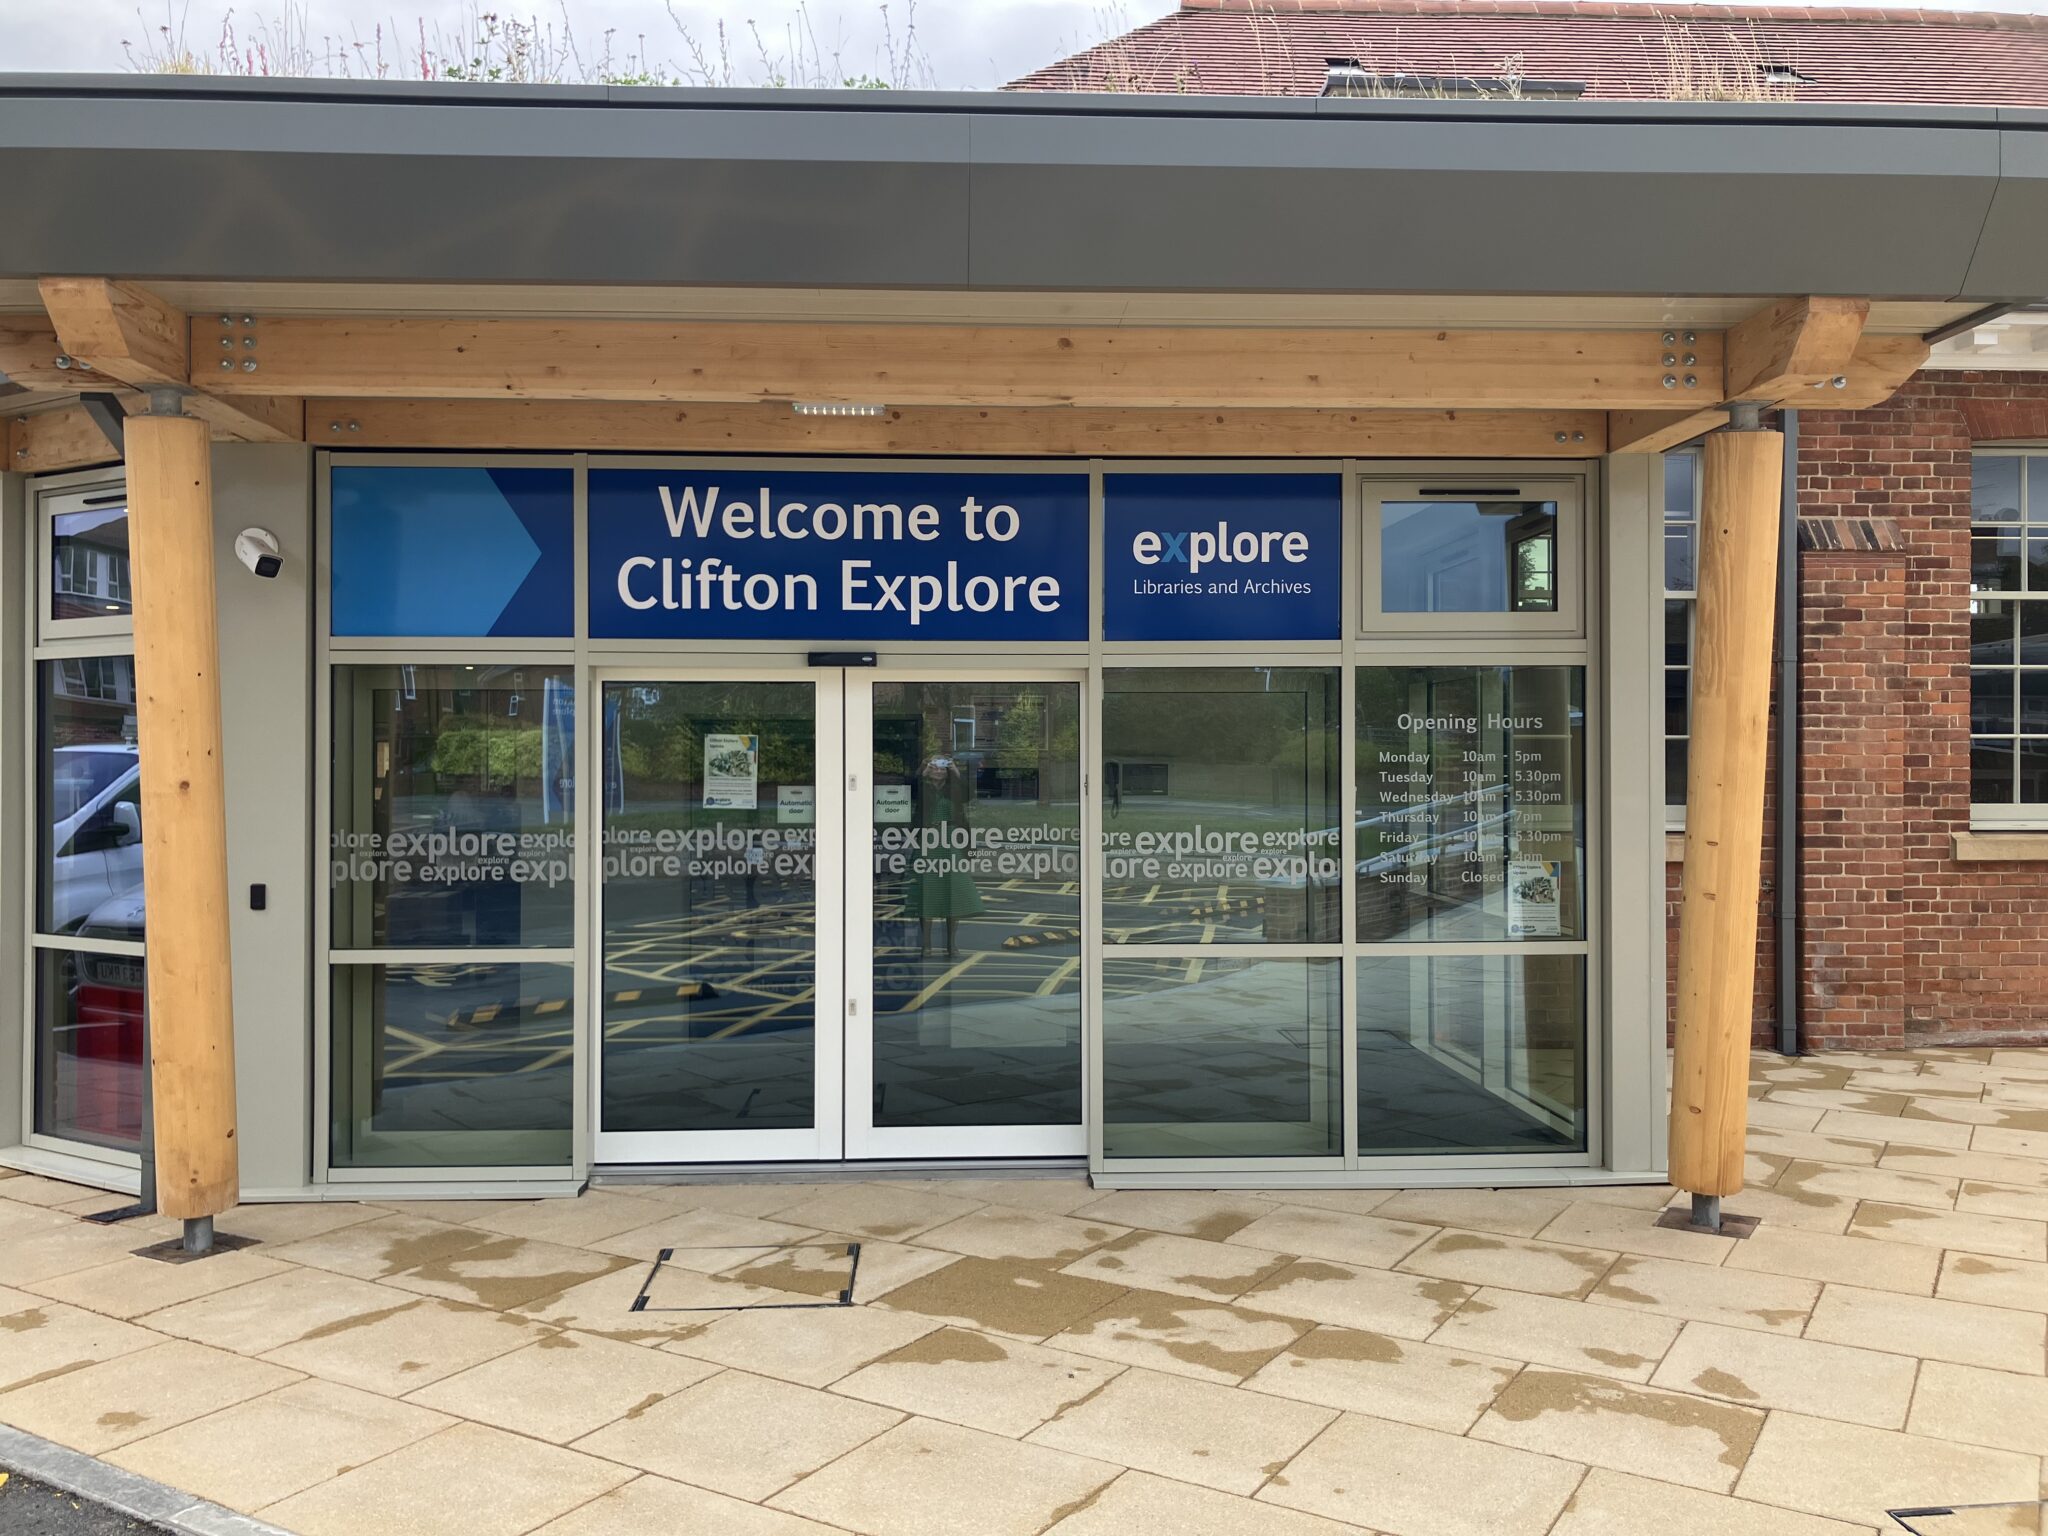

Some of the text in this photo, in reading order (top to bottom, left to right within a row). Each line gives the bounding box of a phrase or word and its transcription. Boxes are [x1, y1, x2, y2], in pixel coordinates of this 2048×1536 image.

[658, 486, 1020, 542] Welcome to
[1133, 521, 1309, 573] explore
[617, 556, 1060, 625] Clifton Explore
[1134, 579, 1311, 594] Libraries and Archives
[1397, 713, 1543, 733] Opening Hours
[1379, 751, 1430, 765] Monday
[1462, 751, 1496, 762] 10am
[1515, 751, 1542, 765] 5pm
[1379, 771, 1433, 785] Tuesday
[1462, 771, 1496, 782] 10am
[1515, 771, 1561, 785] 5.30pm
[1379, 791, 1454, 805] Wednesday
[1462, 791, 1496, 802] 10am
[1515, 791, 1561, 805] 5.30pm
[1379, 811, 1439, 825] Thursday
[1515, 811, 1542, 825] 7pm
[387, 826, 516, 863] explore
[655, 822, 780, 858] explore
[881, 821, 1003, 856] explore
[1007, 823, 1080, 845] explore
[1135, 825, 1259, 861] explore
[1263, 828, 1340, 850] explore
[1379, 831, 1419, 845] Friday
[1463, 831, 1496, 842] 10m
[1515, 831, 1561, 845] 5.30pm
[518, 849, 545, 858] explore
[629, 845, 657, 854] explore
[967, 849, 997, 858] explore
[1463, 851, 1496, 862] 10am
[1515, 851, 1542, 862] 4pm
[478, 856, 509, 865] explore
[913, 854, 993, 877] explore
[997, 846, 1078, 879] explo
[1222, 853, 1253, 863] explore
[420, 861, 504, 886] explore
[688, 856, 769, 879] explore
[1167, 858, 1248, 882] explore
[1379, 871, 1504, 885] Sunday Closed
